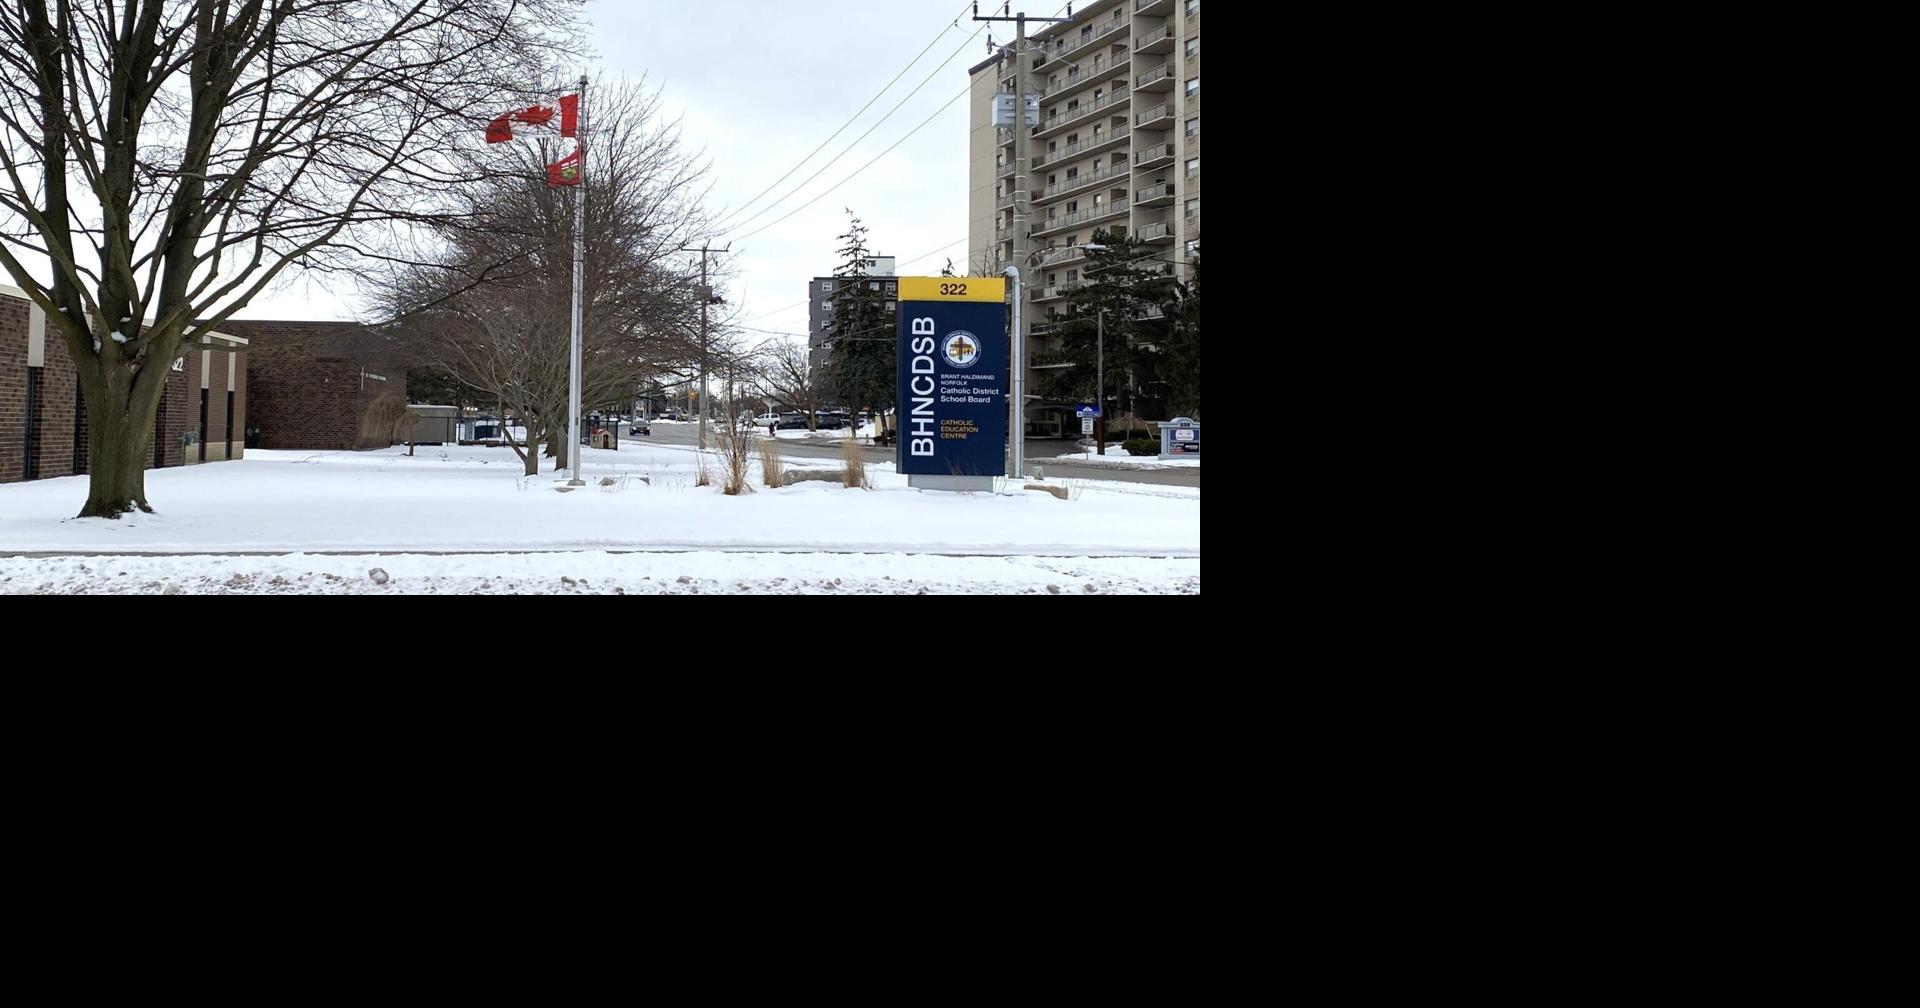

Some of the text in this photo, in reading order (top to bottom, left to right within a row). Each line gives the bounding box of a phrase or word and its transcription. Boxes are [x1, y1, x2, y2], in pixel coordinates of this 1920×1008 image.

[940, 283, 967, 296] 322
[911, 316, 935, 456] BHNCDSB
[972, 387, 999, 395] District
[940, 395, 991, 403] School Board
